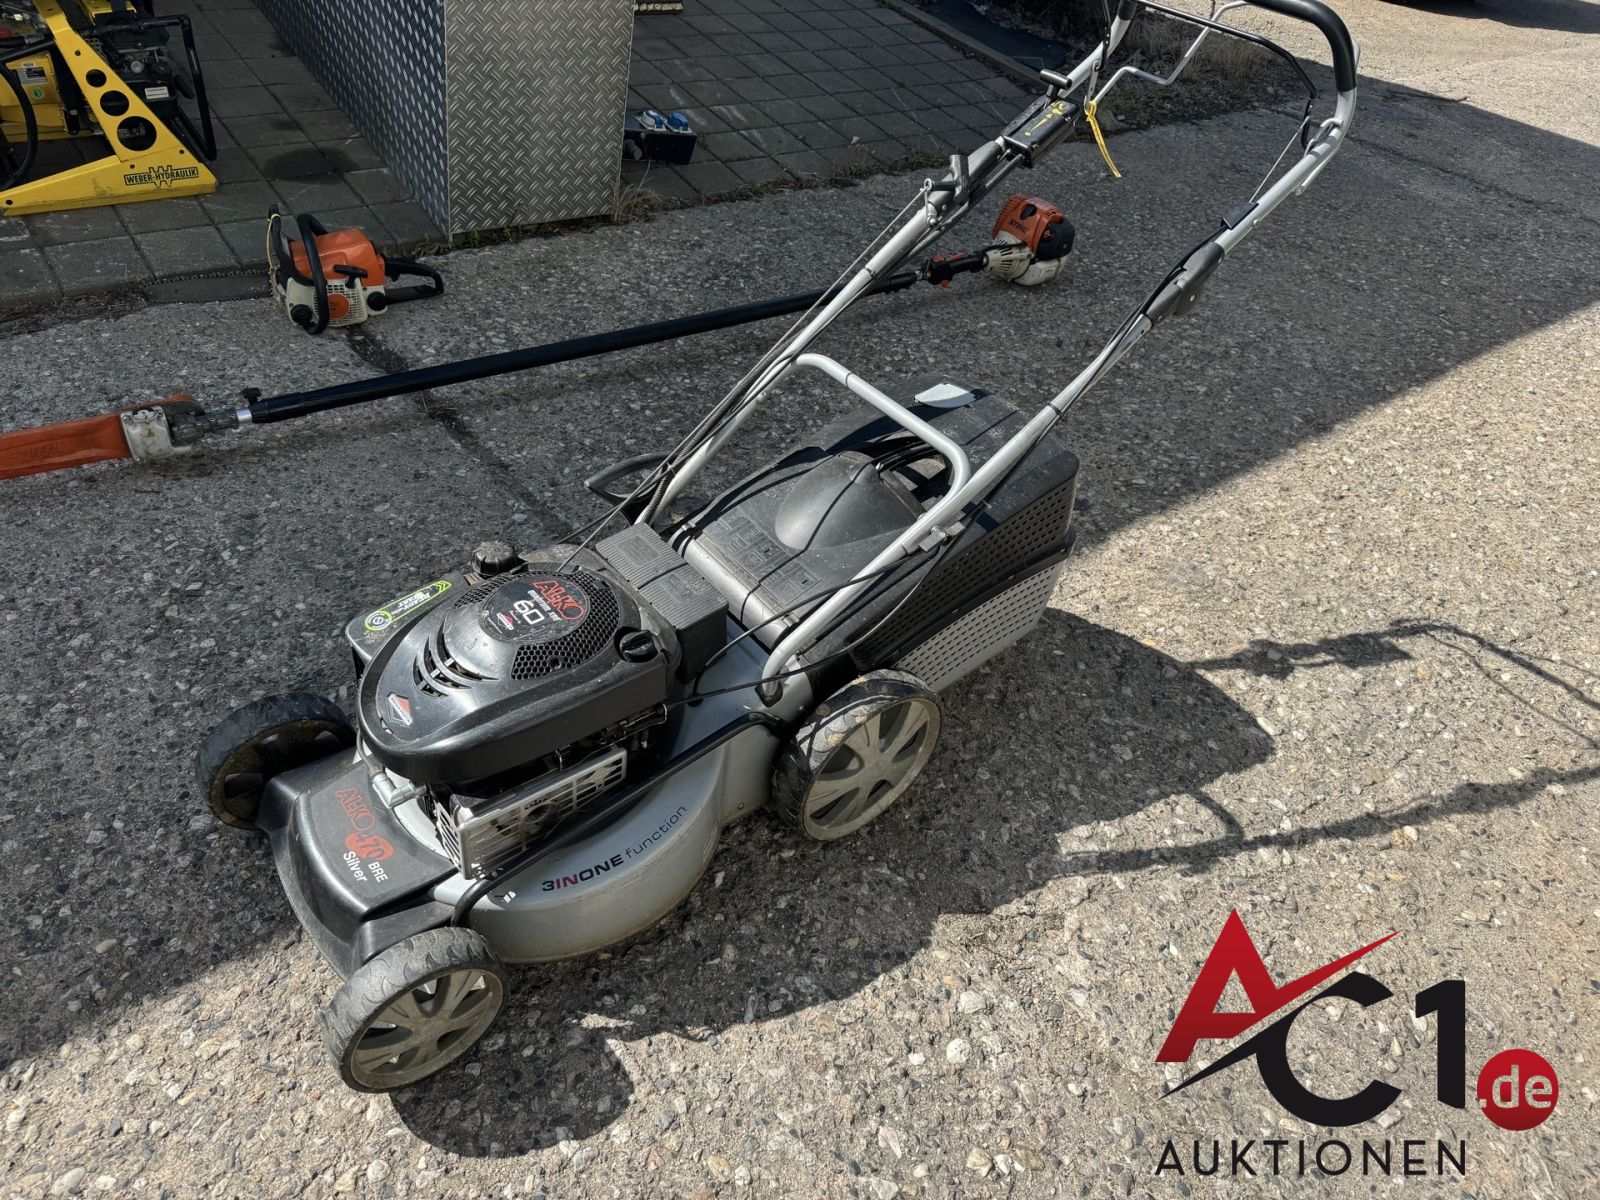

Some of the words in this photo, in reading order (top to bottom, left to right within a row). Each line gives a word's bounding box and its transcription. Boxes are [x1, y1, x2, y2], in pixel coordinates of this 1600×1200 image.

[126, 168, 197, 184] WEBER-HYDRAULIK
[513, 600, 545, 625] 60
[625, 806, 687, 859] function
[343, 851, 368, 882] Silver
[368, 861, 388, 883] BRE
